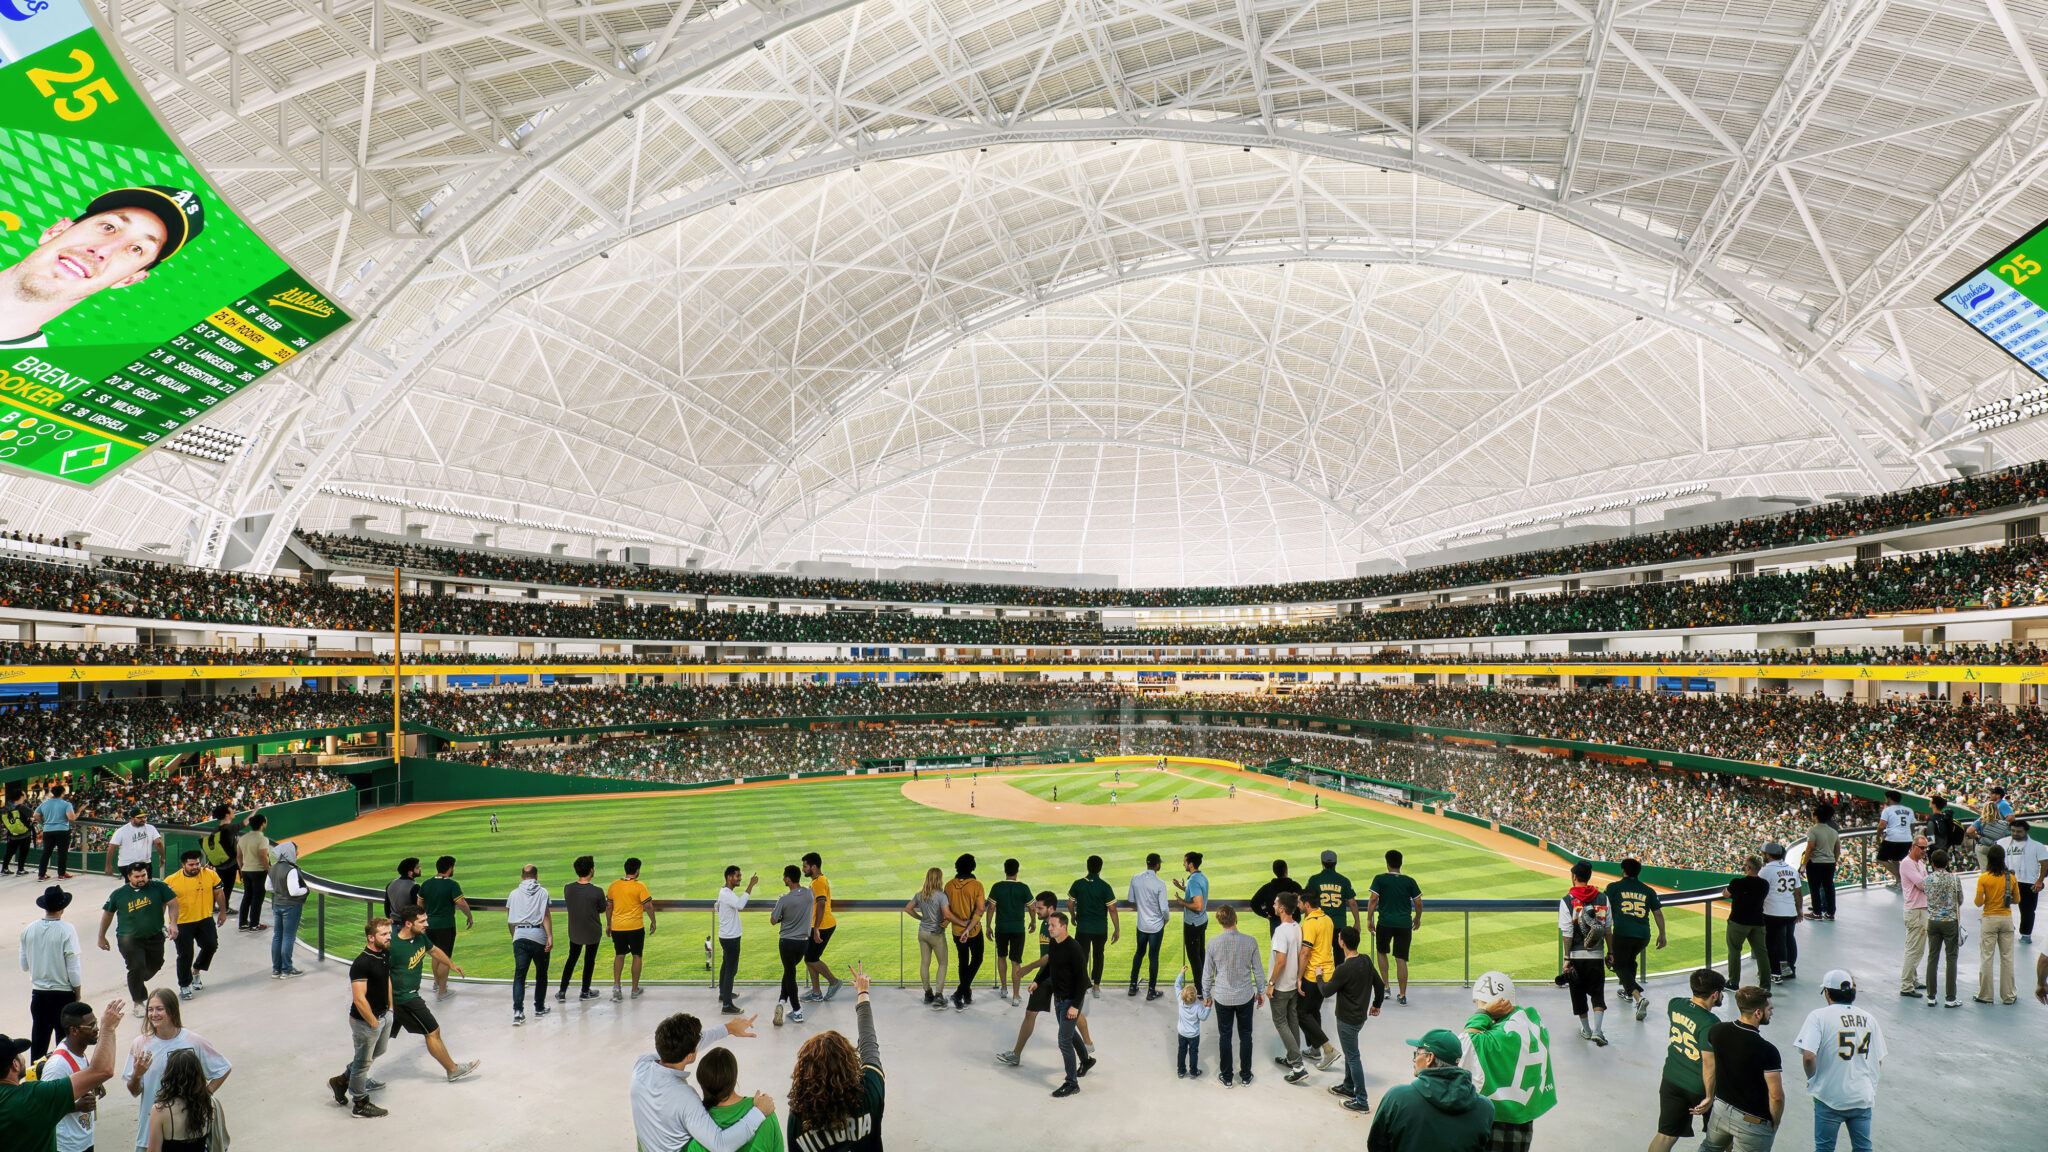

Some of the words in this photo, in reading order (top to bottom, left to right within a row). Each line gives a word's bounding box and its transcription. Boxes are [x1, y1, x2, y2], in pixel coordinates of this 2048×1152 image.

[25, 48, 119, 122] 25
[1998, 253, 2042, 286] 25
[273, 287, 332, 315] Athletics
[1951, 282, 1989, 310] Yankees
[213, 311, 230, 321] 25
[223, 317, 241, 328] DH
[235, 324, 265, 344] ROOKER
[236, 299, 247, 307] 4
[243, 304, 260, 315] RF
[254, 312, 283, 332] BUTLER
[1994, 308, 2019, 324] BELLINGER
[2007, 322, 2023, 333] JUDGE
[192, 323, 209, 334] 33
[203, 329, 220, 339] CF
[214, 336, 246, 354] BLEDAY
[2018, 328, 2040, 342] STANTON
[149, 348, 166, 359] 21
[161, 354, 177, 365] 1B
[173, 361, 224, 388] SODERSTROM
[171, 335, 188, 346] 23
[183, 342, 195, 350] C
[194, 348, 238, 373] LANGELIERS
[12, 356, 91, 392] BRENT
[127, 361, 145, 373] 22
[138, 367, 156, 377] LF
[152, 374, 192, 394] ANDUJAR
[82, 388, 97, 397] 5
[94, 393, 113, 404] SS
[110, 399, 146, 417] WILSON
[104, 375, 123, 386] 20
[116, 380, 135, 391] 2B
[132, 387, 162, 402] GELOF
[179, 407, 200, 418] .291
[0, 411, 21, 423] B
[59, 402, 76, 412] 13
[71, 407, 91, 418] 3B
[88, 412, 129, 432] URSHELA
[69, 667, 87, 680] A's
[1900, 816, 1907, 827] 5
[1776, 877, 1797, 893] 33
[1319, 892, 1342, 908] 25
[1621, 900, 1646, 918] 25
[1477, 976, 1505, 996] A's
[1840, 1014, 1868, 1028] GRAY
[1670, 1026, 1701, 1061] 25
[1838, 1030, 1872, 1061] 54
